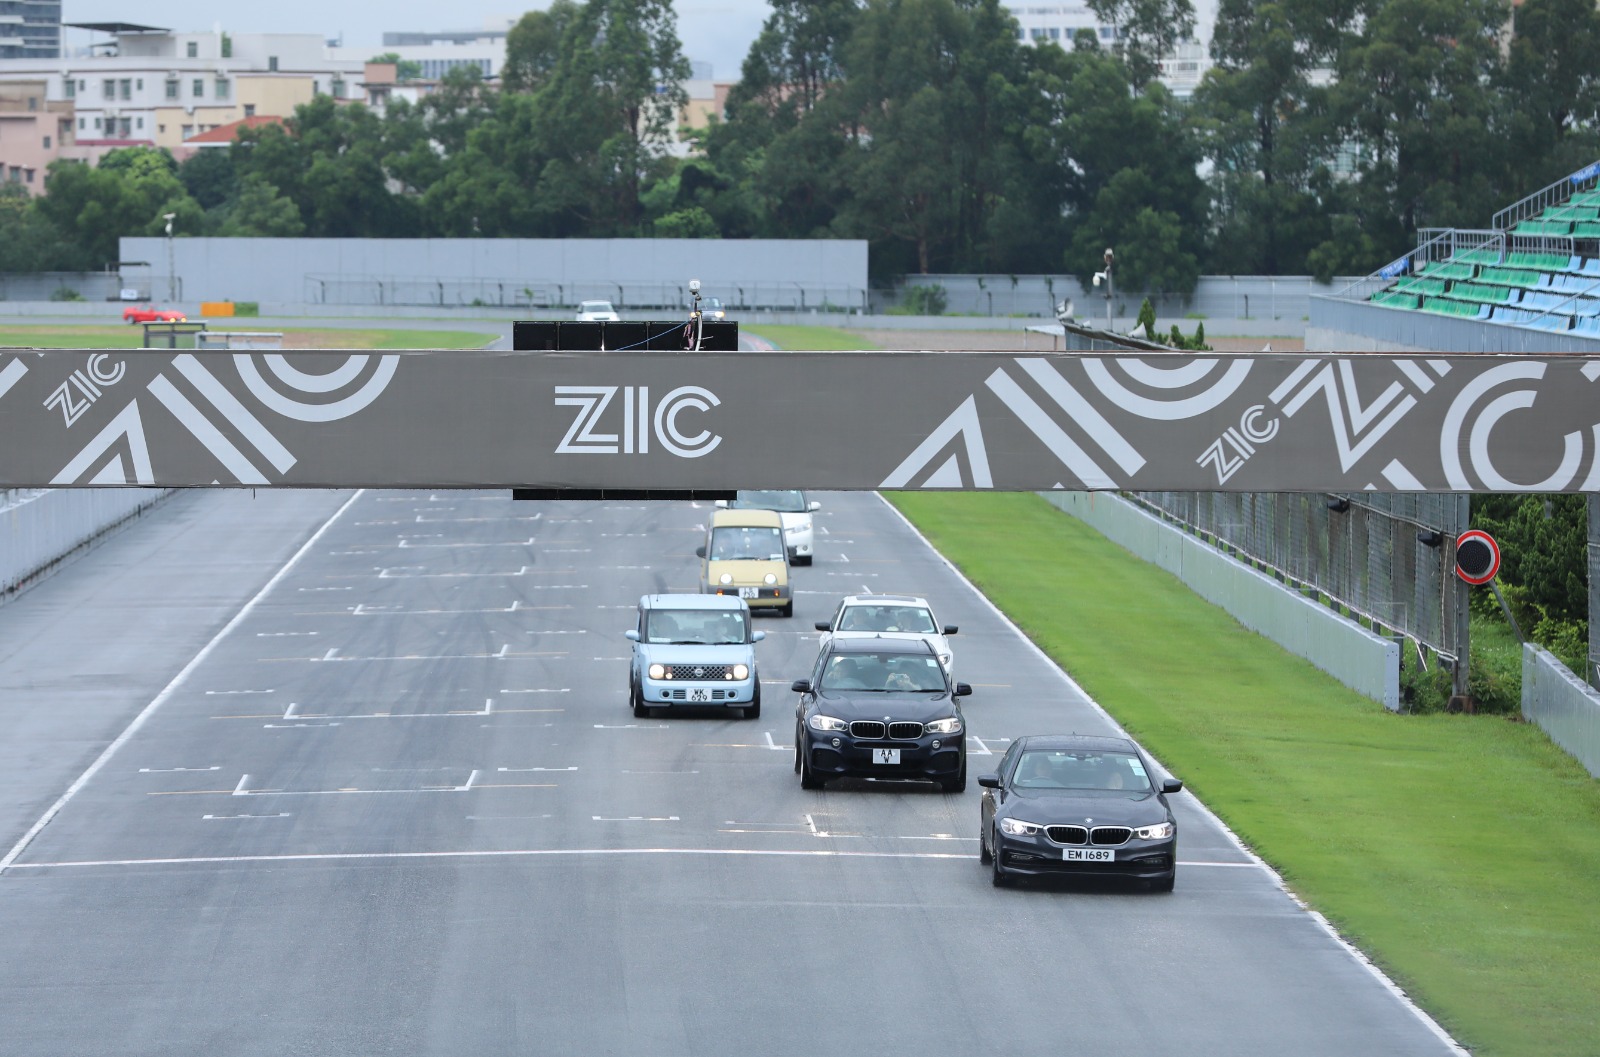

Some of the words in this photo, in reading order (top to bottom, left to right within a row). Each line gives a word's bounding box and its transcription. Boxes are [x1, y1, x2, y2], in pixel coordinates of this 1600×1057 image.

[42, 353, 126, 429] ZIC
[554, 385, 723, 459] ZIC
[1196, 404, 1280, 486] ZIC
[1068, 850, 1082, 860] EM
[1085, 850, 1110, 860] 1689
